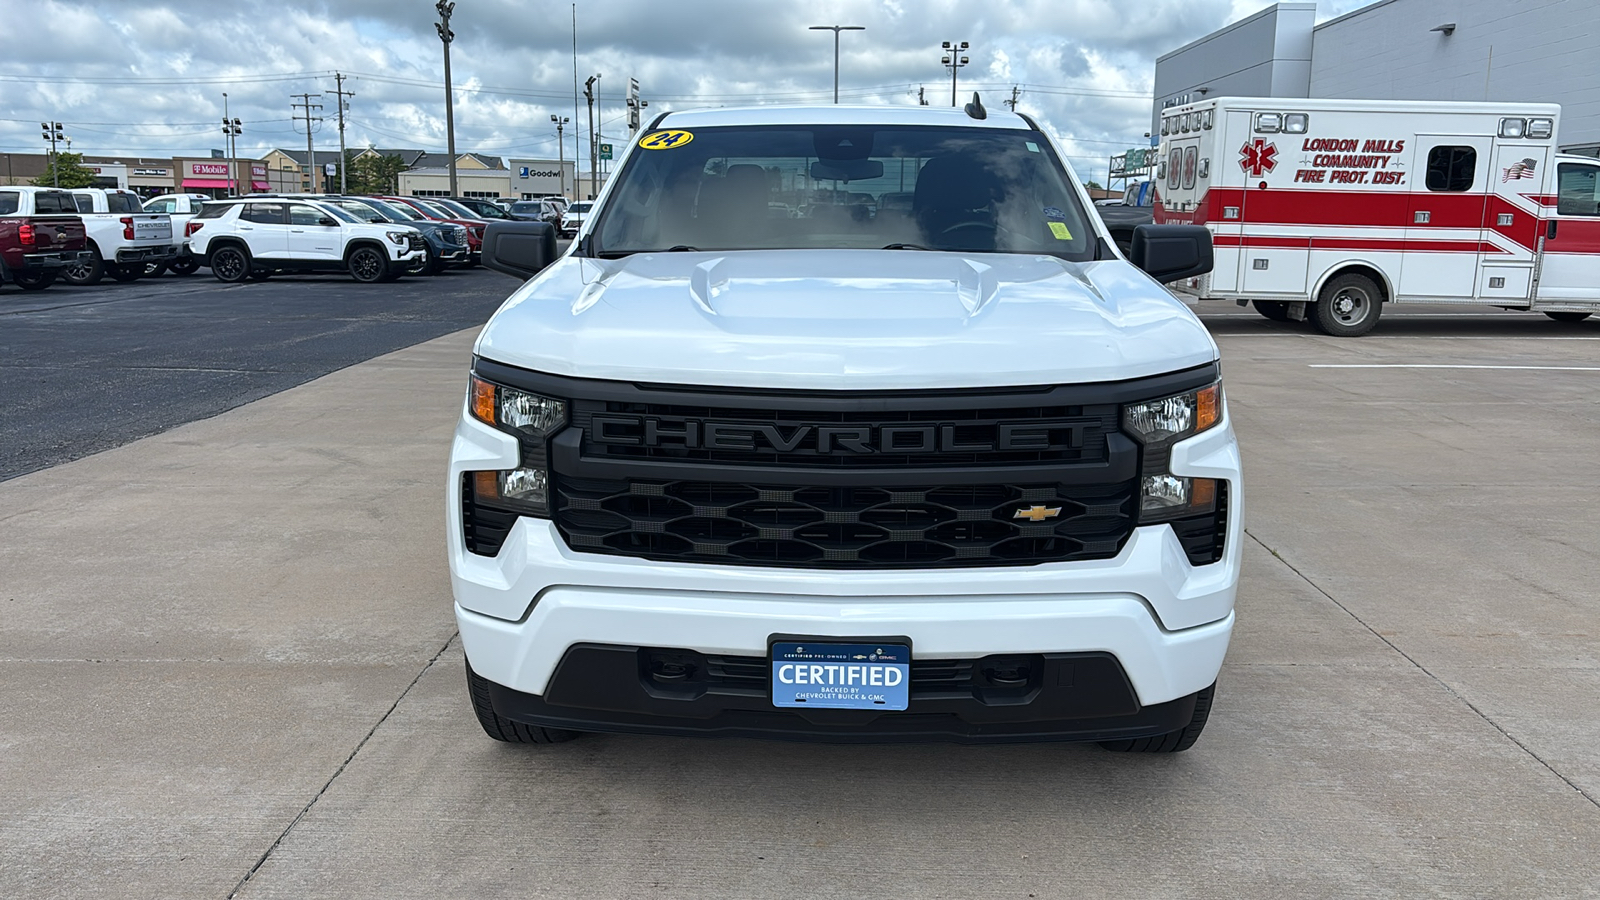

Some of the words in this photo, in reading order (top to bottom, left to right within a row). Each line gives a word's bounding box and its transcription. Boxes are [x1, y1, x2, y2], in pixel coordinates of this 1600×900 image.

[647, 133, 685, 147] 24
[1302, 138, 1359, 152] LONDON
[1362, 139, 1405, 153] MILLS
[1312, 154, 1391, 168] COMMUNITY
[201, 165, 226, 173] Mobile
[1294, 169, 1326, 183] FIRE
[1329, 170, 1368, 184] PROT.
[1371, 171, 1405, 185] DIST.
[591, 414, 1101, 454] CHEVROLET
[778, 664, 902, 687] CERTIFIED
